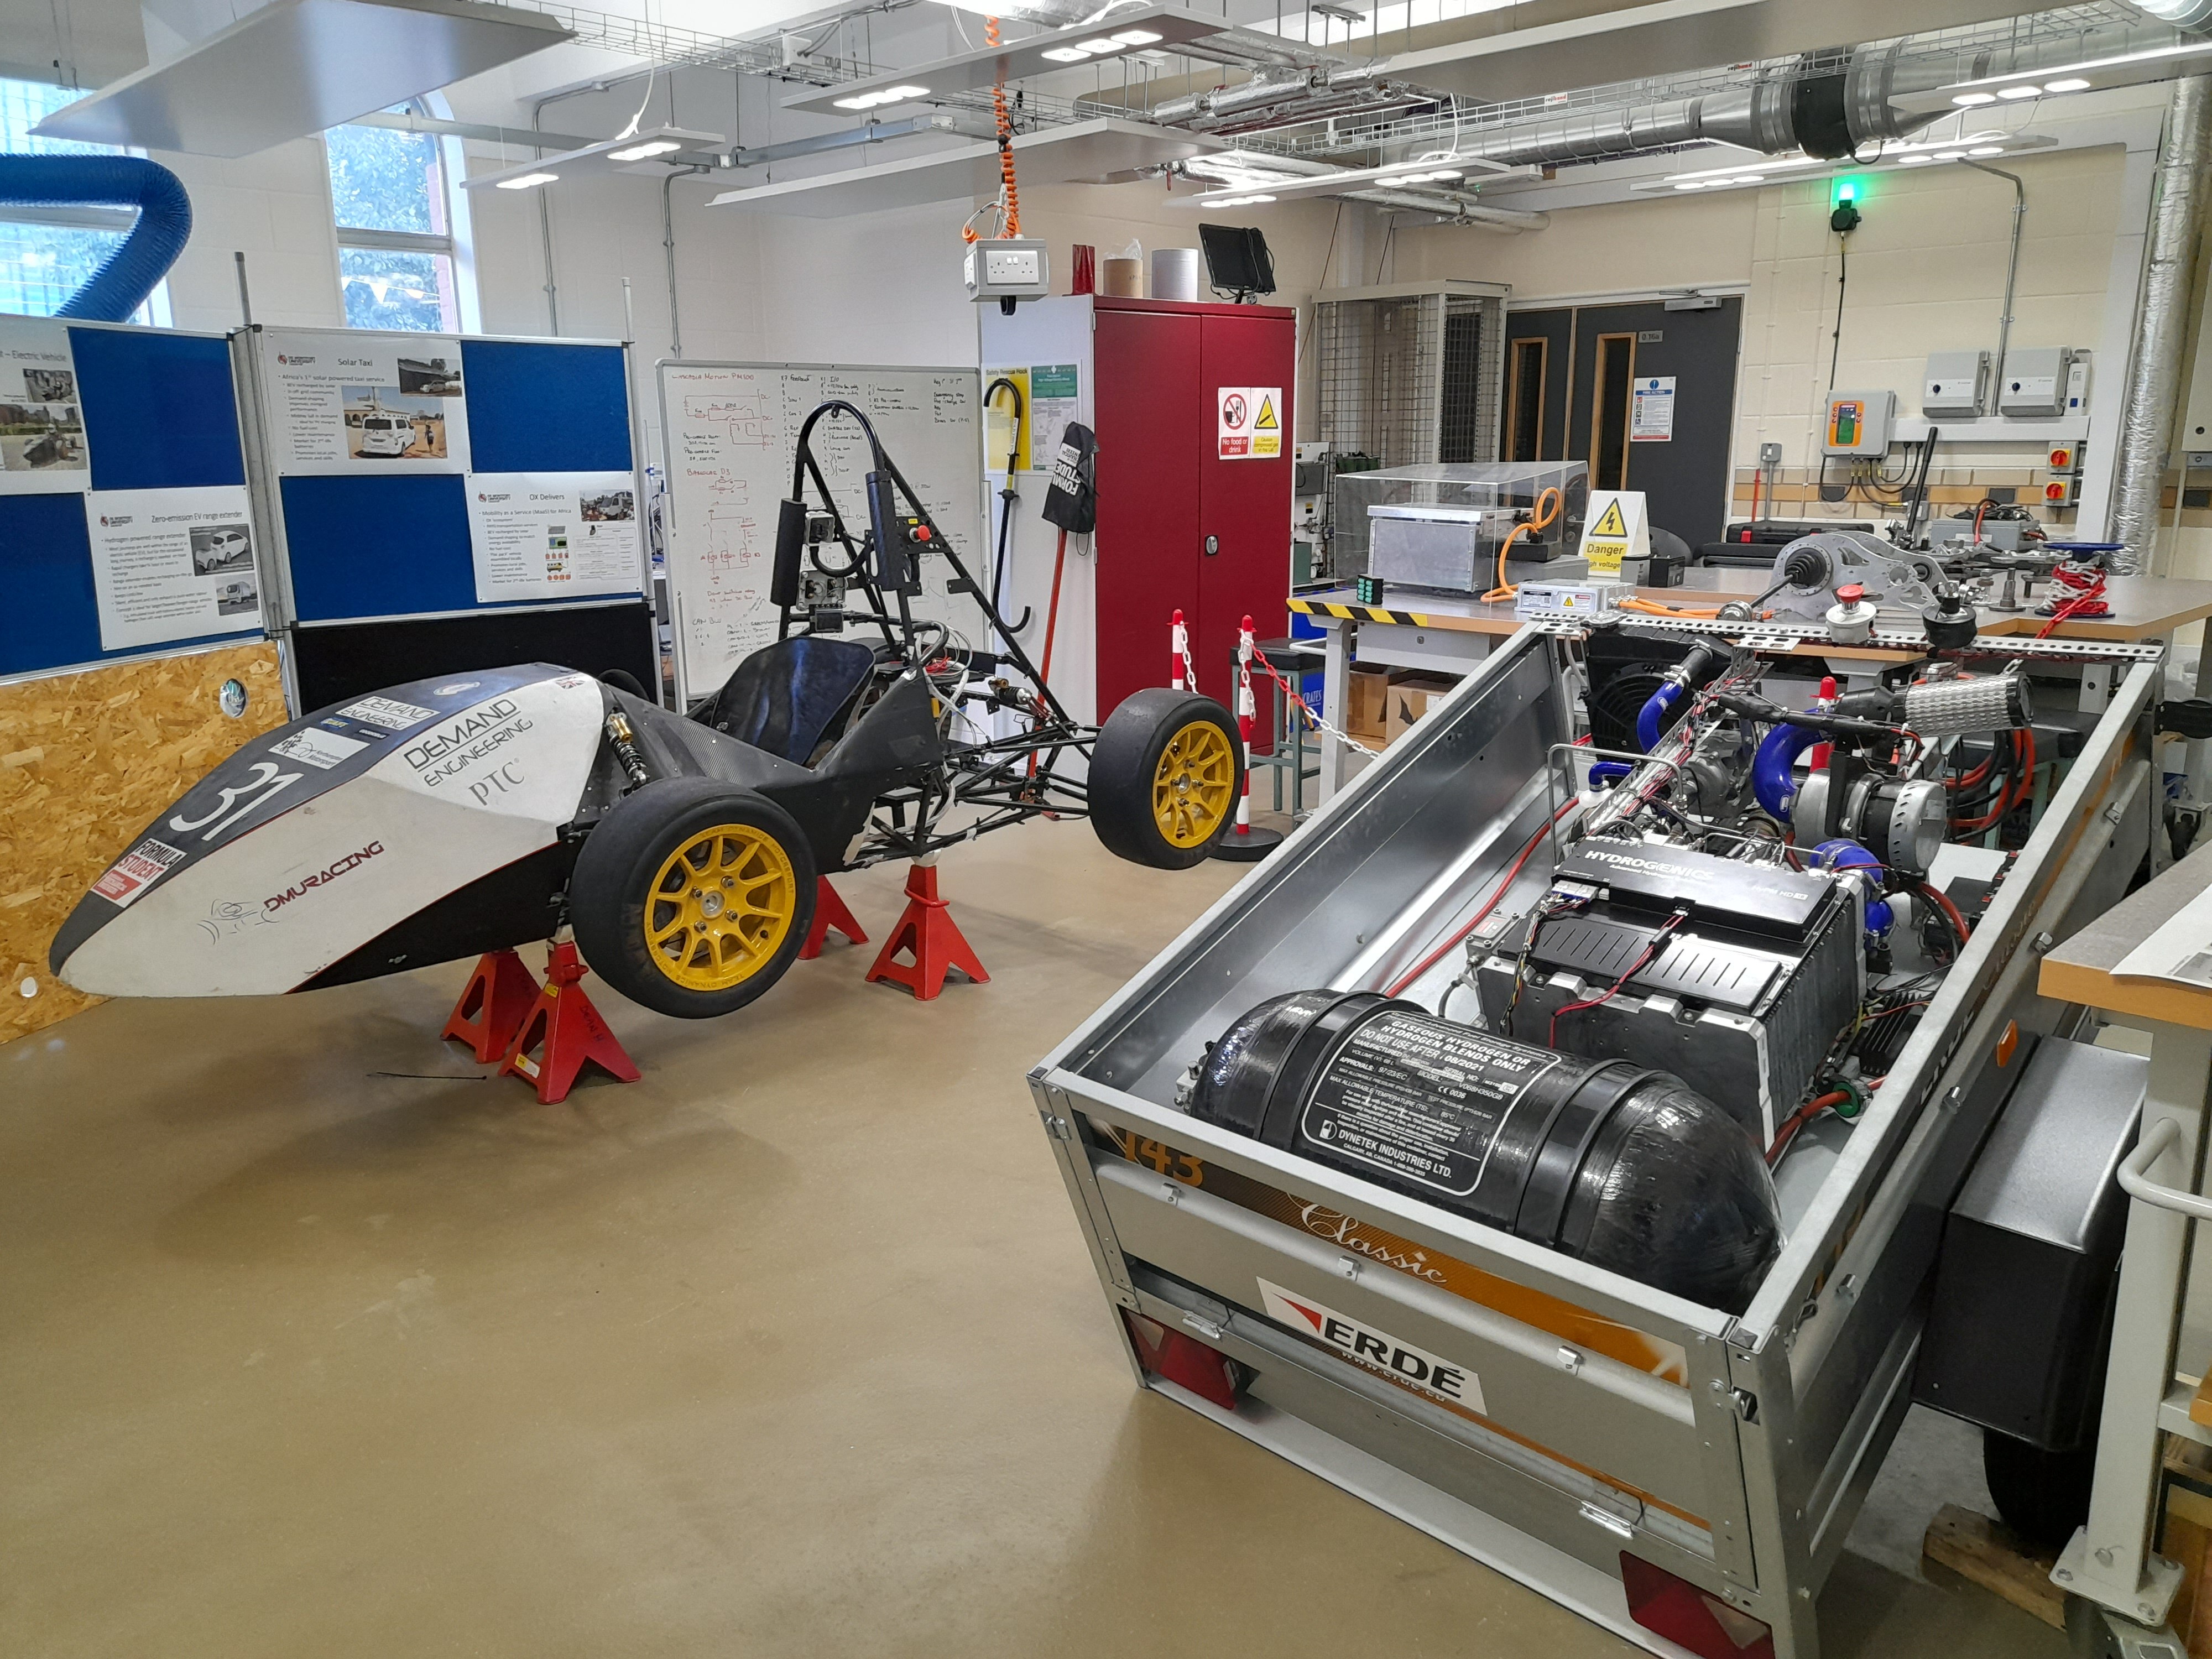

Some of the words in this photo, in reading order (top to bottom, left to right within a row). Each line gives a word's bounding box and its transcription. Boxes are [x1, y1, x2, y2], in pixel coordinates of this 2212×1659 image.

[151, 514, 194, 523] Zero-emission
[194, 513, 202, 521] EV
[203, 513, 218, 521] range
[1587, 544, 1624, 556] Danger
[341, 708, 406, 729] ENGINEERING
[360, 697, 435, 719] DEMAND
[404, 699, 517, 769] DEMAND
[424, 718, 533, 787] ENGINEERING
[468, 761, 525, 806] PTC
[169, 762, 305, 841] 31
[118, 854, 165, 881] STUDENT
[134, 840, 182, 868] FORMULA
[1609, 864, 1641, 874] Advanced
[263, 841, 384, 911] DMURACING
[1352, 1048, 1374, 1059] VOLUME
[1353, 1039, 1403, 1057] MANUFACTURED
[1360, 1029, 1375, 1039] DO
[1375, 1032, 1395, 1045] NOT
[1392, 1037, 1412, 1050] USE
[1410, 1044, 1441, 1060] AFTER
[1444, 1055, 1485, 1072] 08/2021
[1381, 1025, 1444, 1048] HYDROGEN
[1443, 1043, 1491, 1063] BLENDS
[1492, 1058, 1526, 1072] ONLY
[1391, 1021, 1446, 1040] GASEOUS
[1446, 1036, 1511, 1060] HYDROGEN
[1512, 1056, 1531, 1066] OR
[1481, 1037, 1511, 1048] Storage
[1339, 1056, 1375, 1072] APPROVALS:
[1378, 1066, 1408, 1081] 97/23/EC
[1443, 1066, 1465, 1078] SERIAL
[1466, 1074, 1480, 1082] NO:
[1329, 1074, 1342, 1083] MAX
[1341, 1078, 1374, 1094] ALLOWABLE
[1375, 1089, 1416, 1108] TEMPERATURE
[1417, 1070, 1443, 1083] MODEL:
[1458, 1082, 1504, 1100] V068H350G8
[1449, 1089, 1467, 1099] 0036
[1125, 1128, 1204, 1188] 143
[1338, 1129, 1379, 1151] DYNETEK
[1379, 1144, 1432, 1171] INDUSTRIES
[1433, 1163, 1452, 1178] LTD.
[1286, 1192, 1447, 1284] Classic
[1324, 1317, 1465, 1399] ERDÉ
